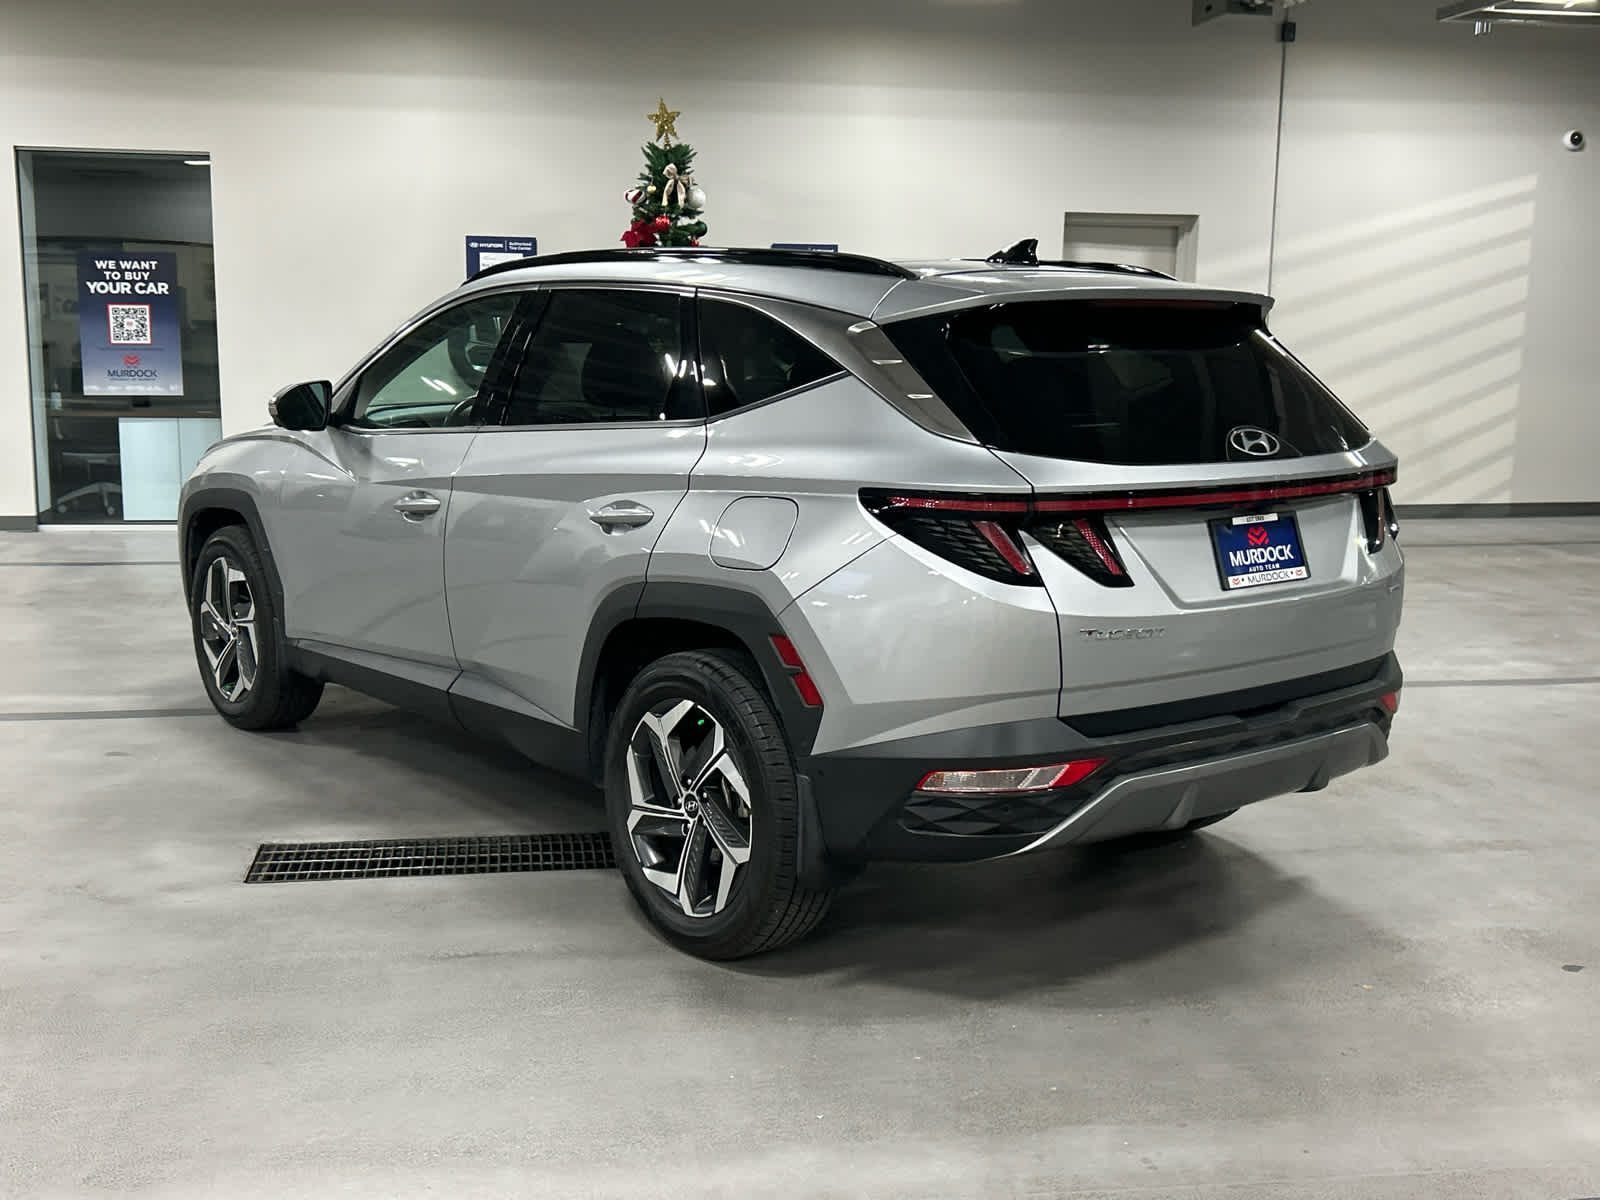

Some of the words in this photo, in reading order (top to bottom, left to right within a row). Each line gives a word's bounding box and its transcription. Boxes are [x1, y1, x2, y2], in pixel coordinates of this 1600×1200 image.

[95, 260, 116, 270] WE
[119, 260, 158, 270] WANT
[104, 271, 121, 281] TO
[124, 271, 150, 281] BUY
[86, 281, 132, 294] YOUR
[134, 282, 169, 295] CAR
[107, 369, 159, 378] MURDOCK
[1229, 544, 1295, 567] MURDOCK
[1247, 571, 1290, 584] MURDOCK
